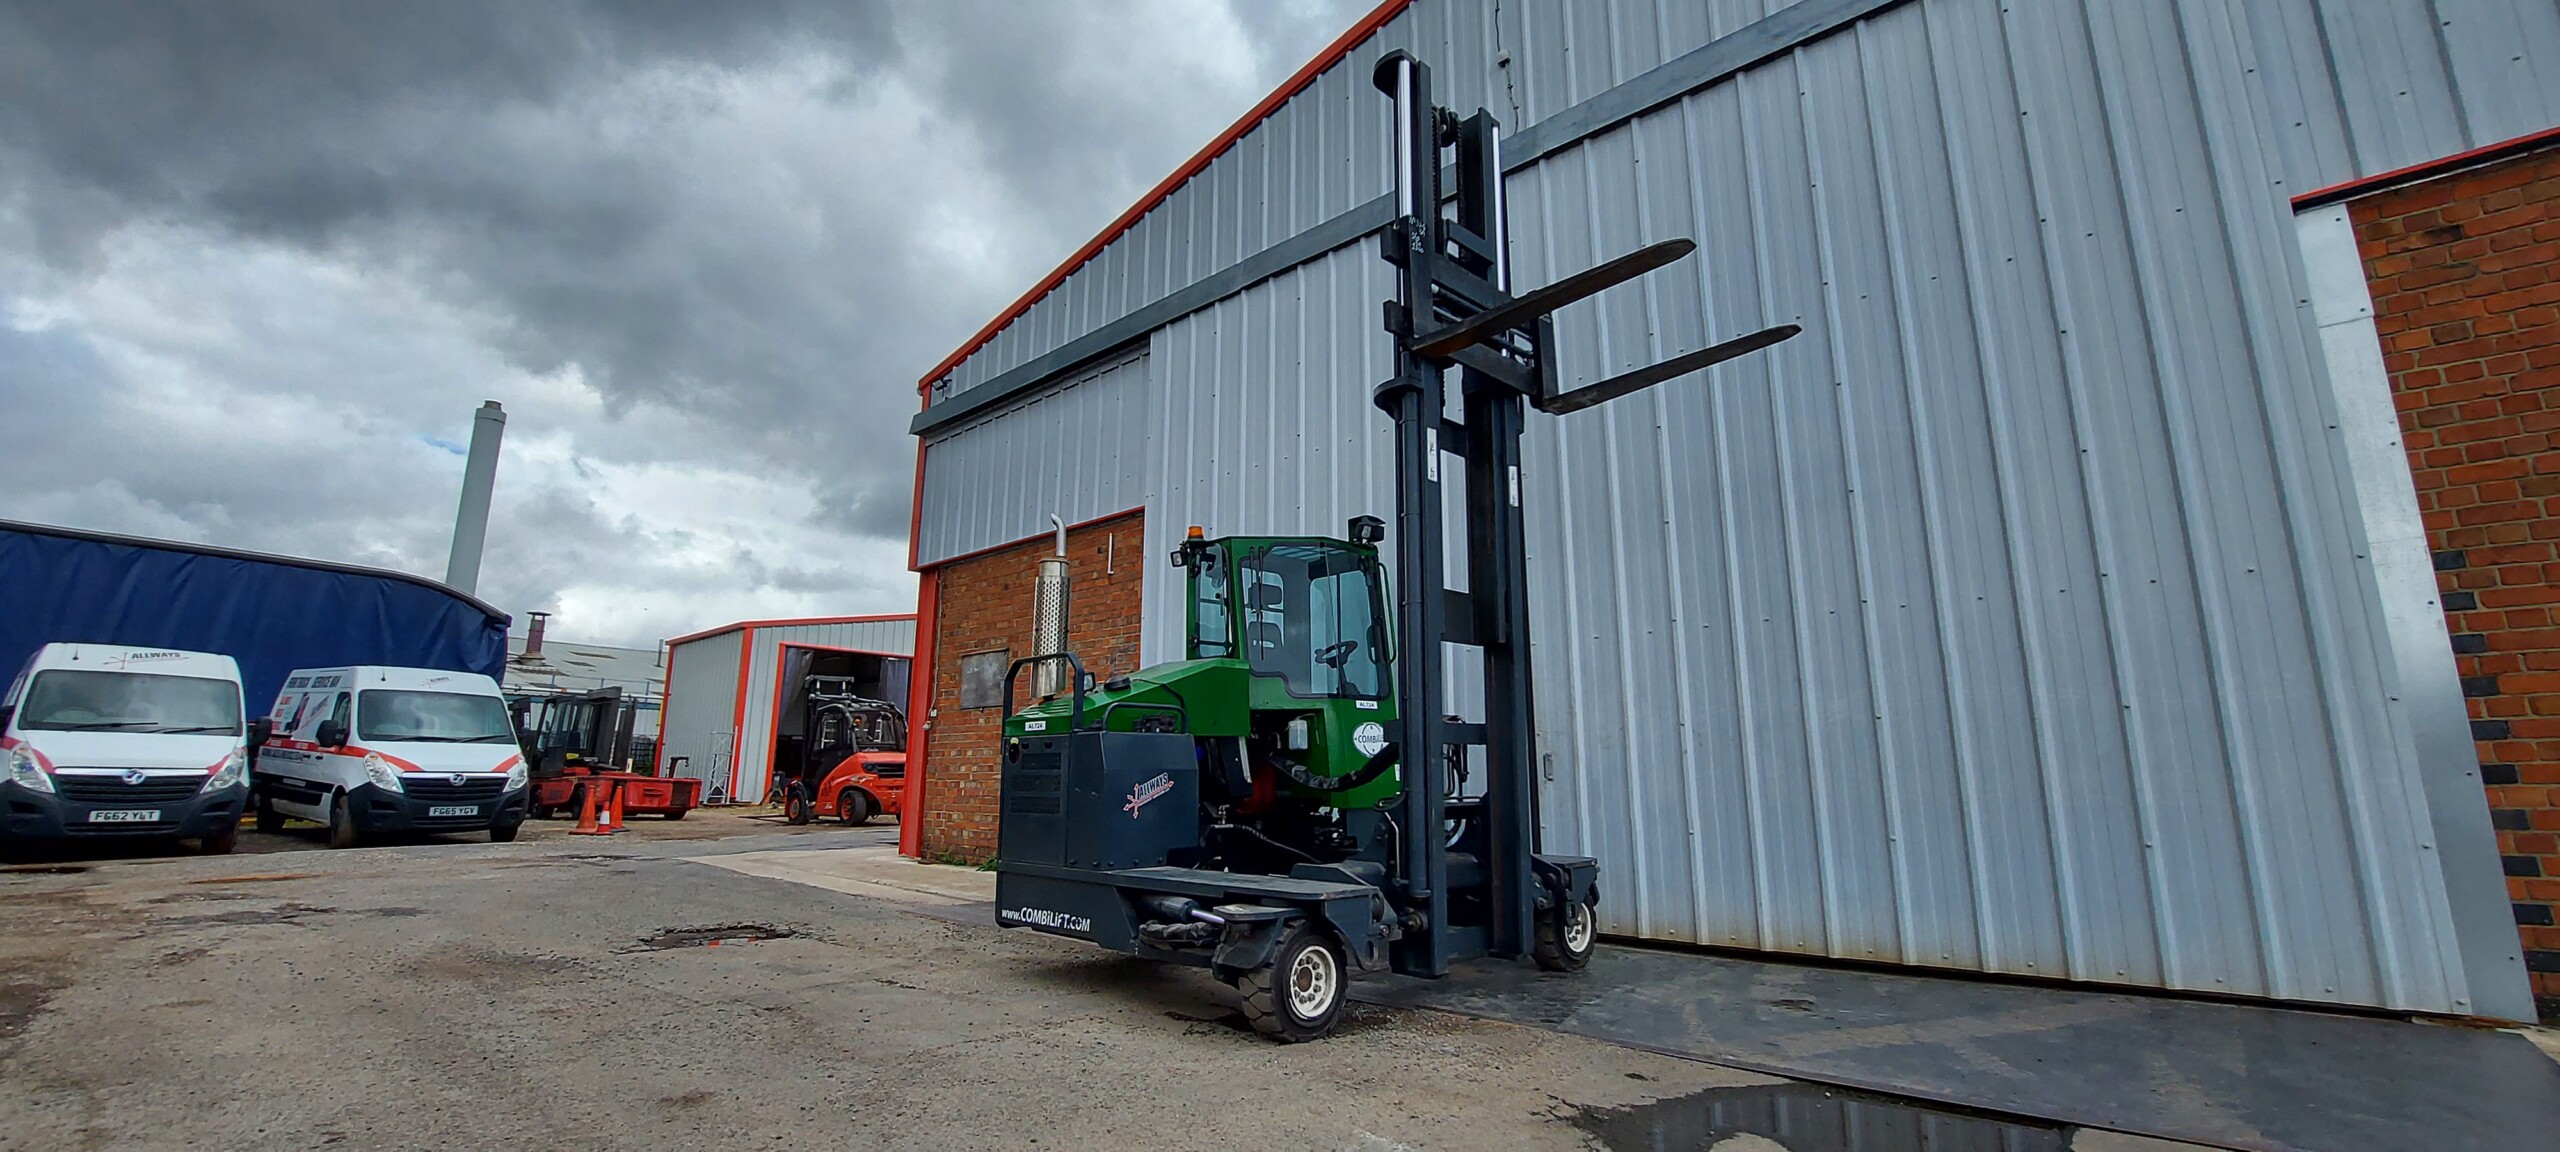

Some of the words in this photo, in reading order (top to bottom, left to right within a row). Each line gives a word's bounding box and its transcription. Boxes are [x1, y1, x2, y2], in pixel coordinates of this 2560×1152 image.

[1139, 772, 1168, 799] ALLWAYS
[433, 807, 457, 815] FG65
[95, 812, 128, 820] FG62
